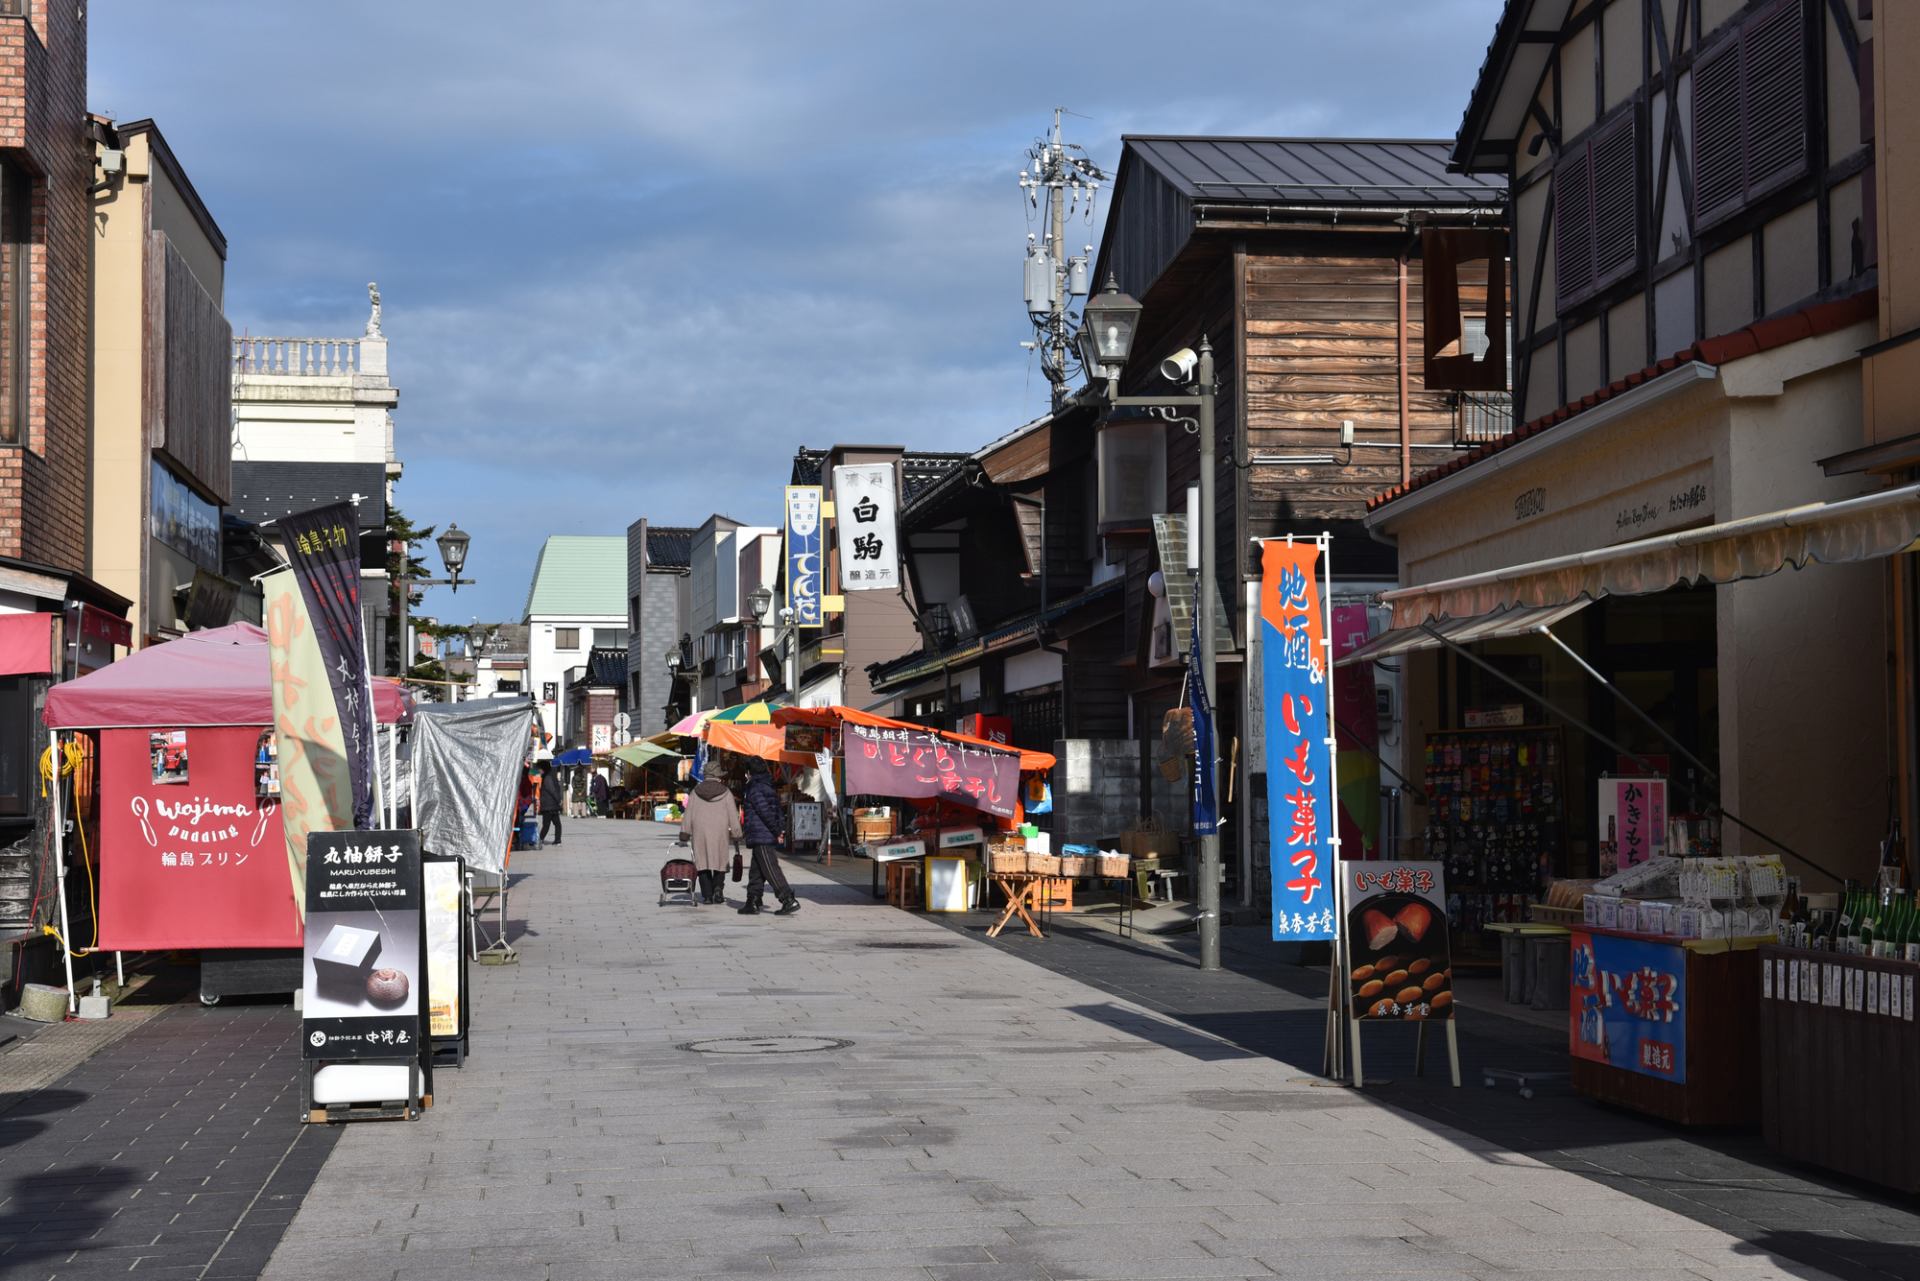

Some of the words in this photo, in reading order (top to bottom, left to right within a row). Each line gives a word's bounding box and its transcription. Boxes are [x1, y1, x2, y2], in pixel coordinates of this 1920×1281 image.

[852, 495, 884, 561] 白駒
[156, 796, 253, 826] Wajima
[168, 824, 239, 843] pudding
[1624, 783, 1643, 866] かきもち
[161, 851, 249, 867] 輪島プリン
[323, 844, 404, 865] 丸柚餅子
[330, 868, 397, 877] MARU-YUBESHI
[1355, 867, 1435, 893] いも菓子
